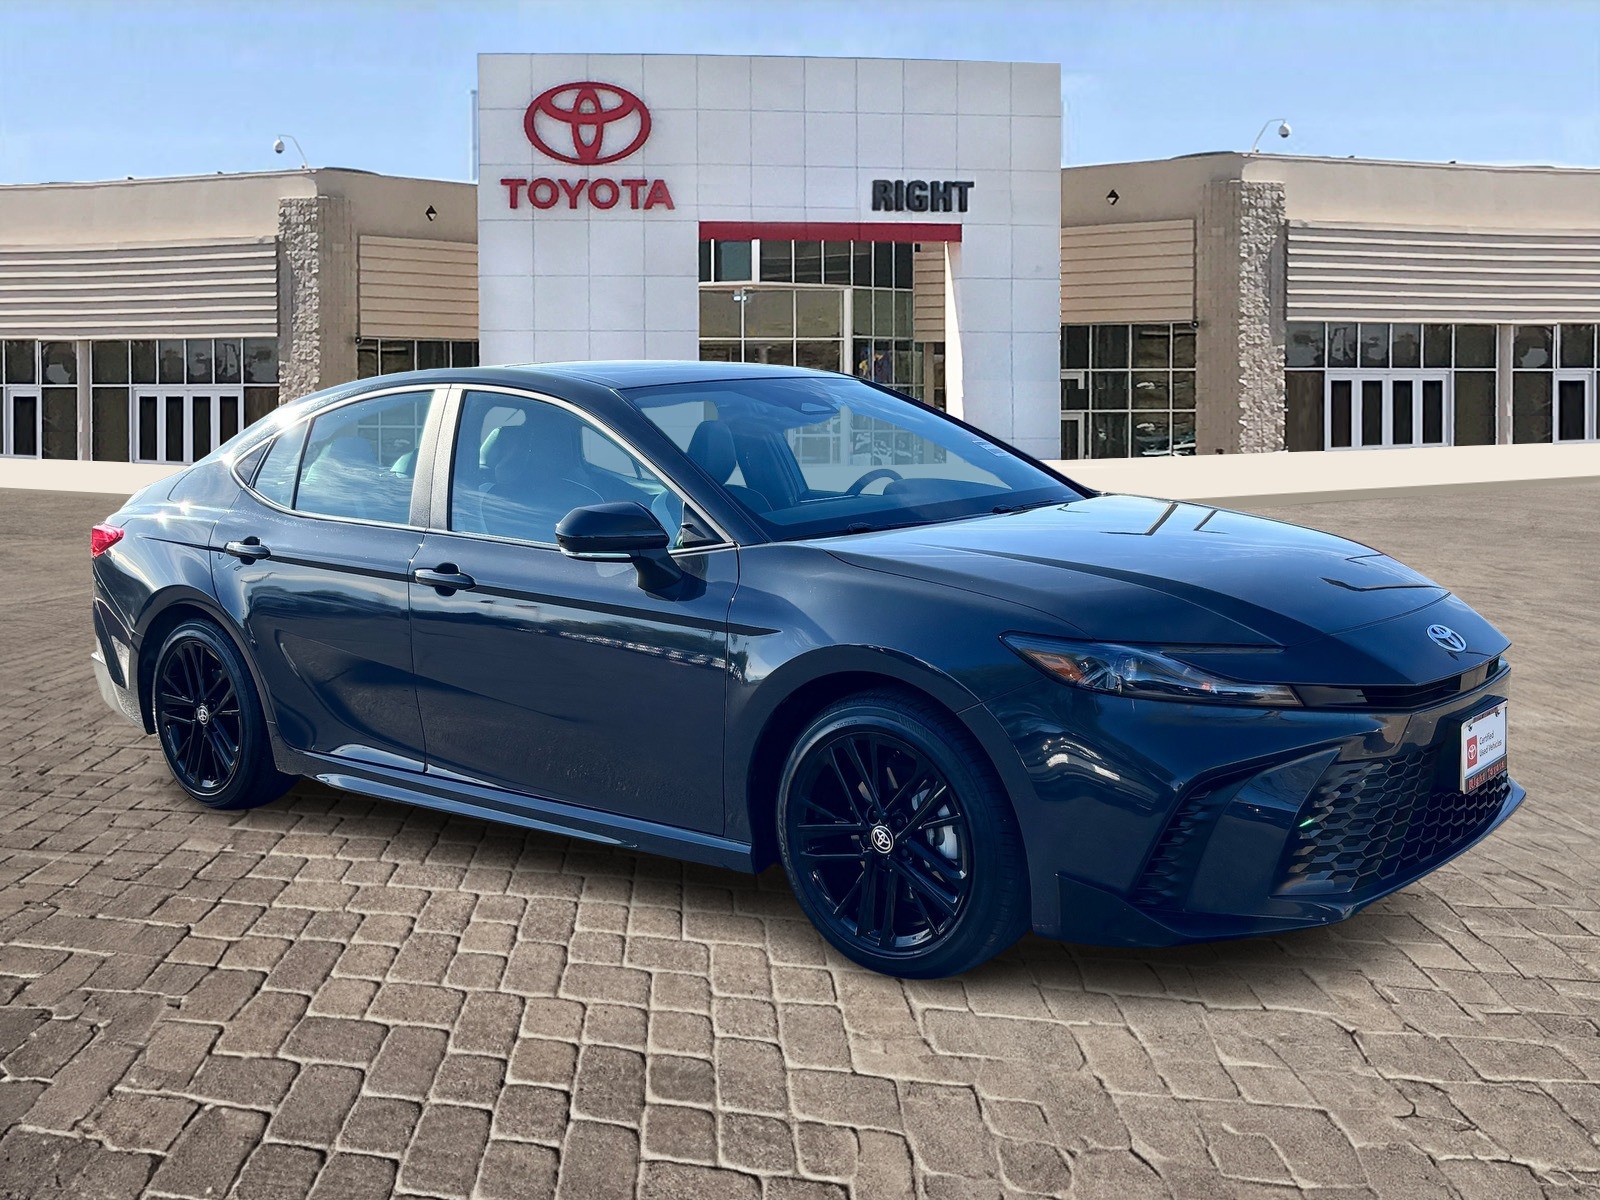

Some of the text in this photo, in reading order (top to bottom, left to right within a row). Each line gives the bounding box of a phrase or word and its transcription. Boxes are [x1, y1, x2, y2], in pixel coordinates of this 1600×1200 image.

[500, 178, 675, 209] TOYOTA
[872, 179, 975, 212] RIGHT
[1479, 730, 1494, 745] Certified
[1479, 739, 1502, 757] Used Vehicles
